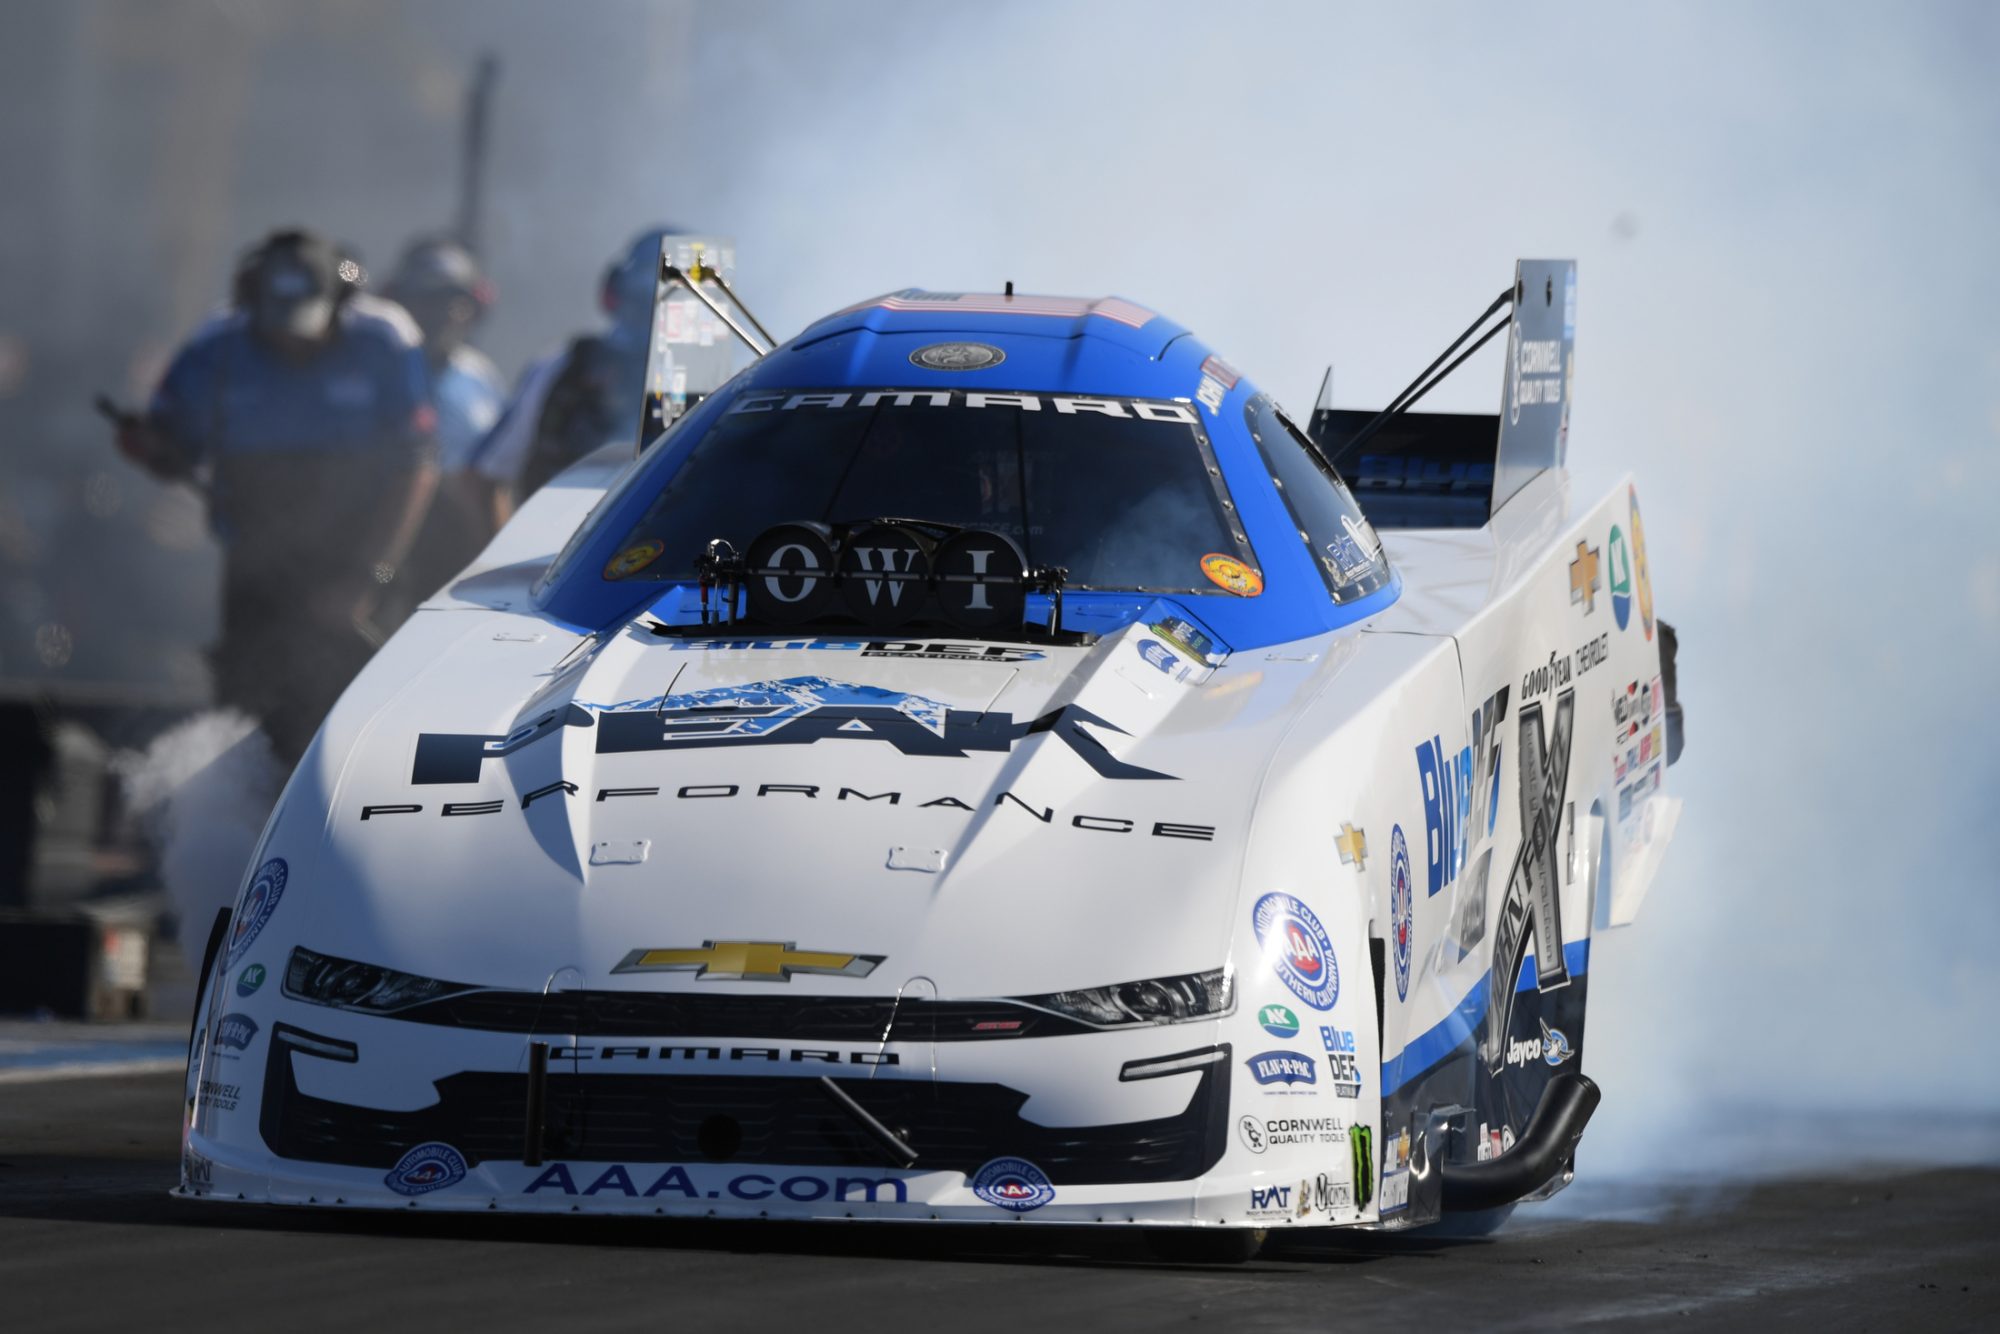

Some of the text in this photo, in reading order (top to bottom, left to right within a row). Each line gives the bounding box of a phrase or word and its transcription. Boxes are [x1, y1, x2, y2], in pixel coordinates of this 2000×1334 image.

[728, 391, 1199, 424] CAMARO
[359, 779, 1216, 841] PERFORMANCE
[1300, 906, 1327, 941] CLUB
[1320, 1026, 1355, 1052] Blue
[1507, 1035, 1541, 1068] Jayco
[549, 1045, 900, 1066] CAMARO
[1266, 1118, 1343, 1132] CORNWELL
[1269, 1133, 1345, 1144] QUALITY TOOLS
[522, 1162, 908, 1203] AAA.com
[1251, 1185, 1291, 1209] RMT
